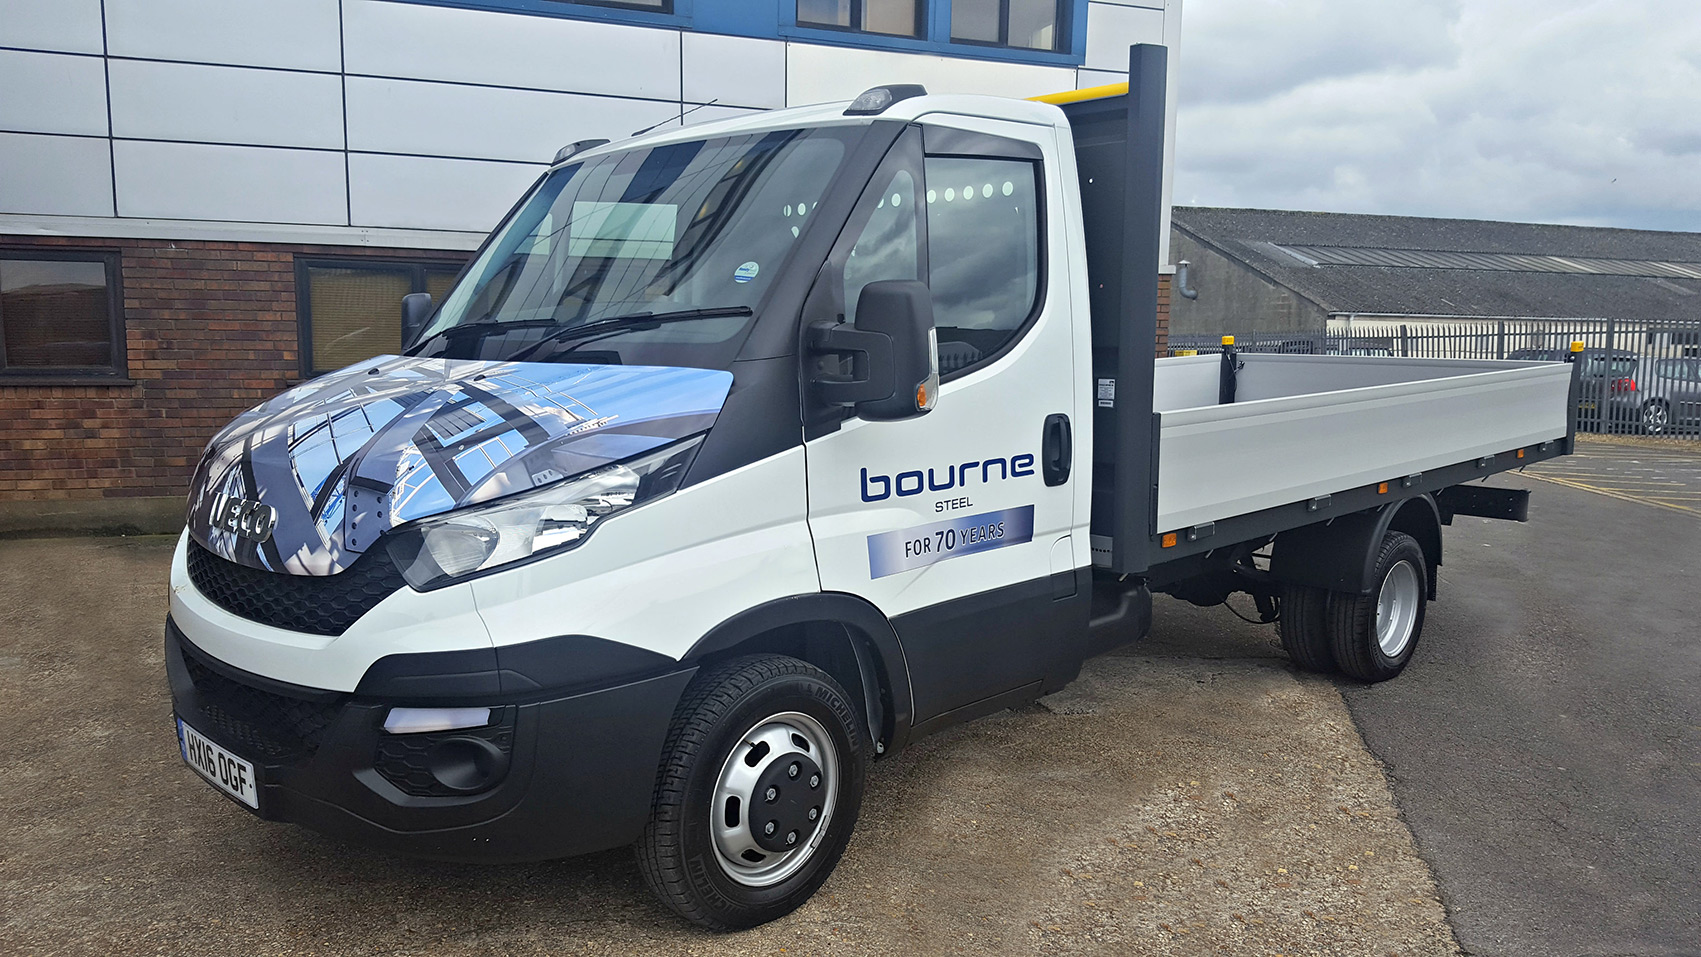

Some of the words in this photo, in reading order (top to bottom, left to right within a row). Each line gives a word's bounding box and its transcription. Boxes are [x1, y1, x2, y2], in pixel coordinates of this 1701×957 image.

[860, 453, 1035, 502] bourne
[935, 497, 973, 512] STEEL
[905, 537, 931, 558] FOR
[935, 529, 956, 553] 70
[961, 522, 1005, 545] YEARS
[187, 730, 216, 777] HX16
[218, 752, 246, 796] OGF
